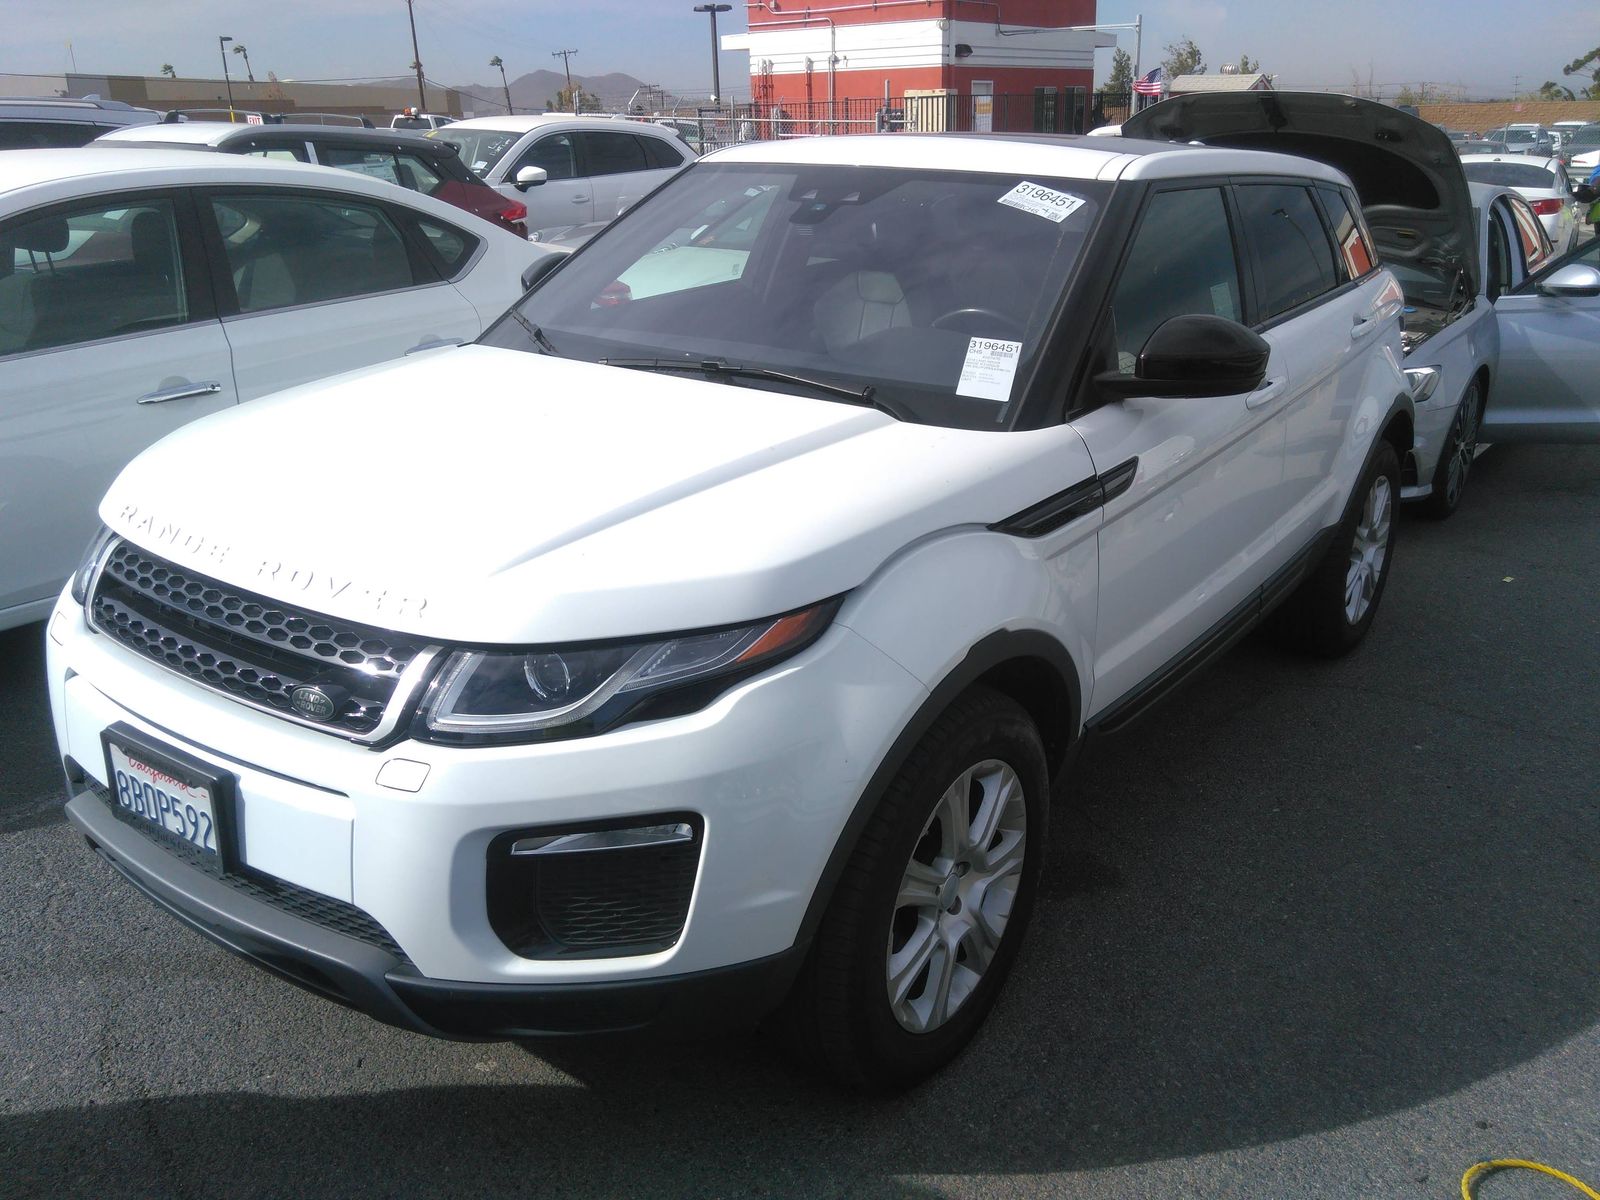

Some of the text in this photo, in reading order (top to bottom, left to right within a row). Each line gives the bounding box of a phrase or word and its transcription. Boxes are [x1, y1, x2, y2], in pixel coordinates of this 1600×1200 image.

[1016, 184, 1077, 209] 3196451
[970, 340, 1020, 353] 3196451
[299, 691, 320, 703] LAND
[300, 701, 327, 715] ROVER
